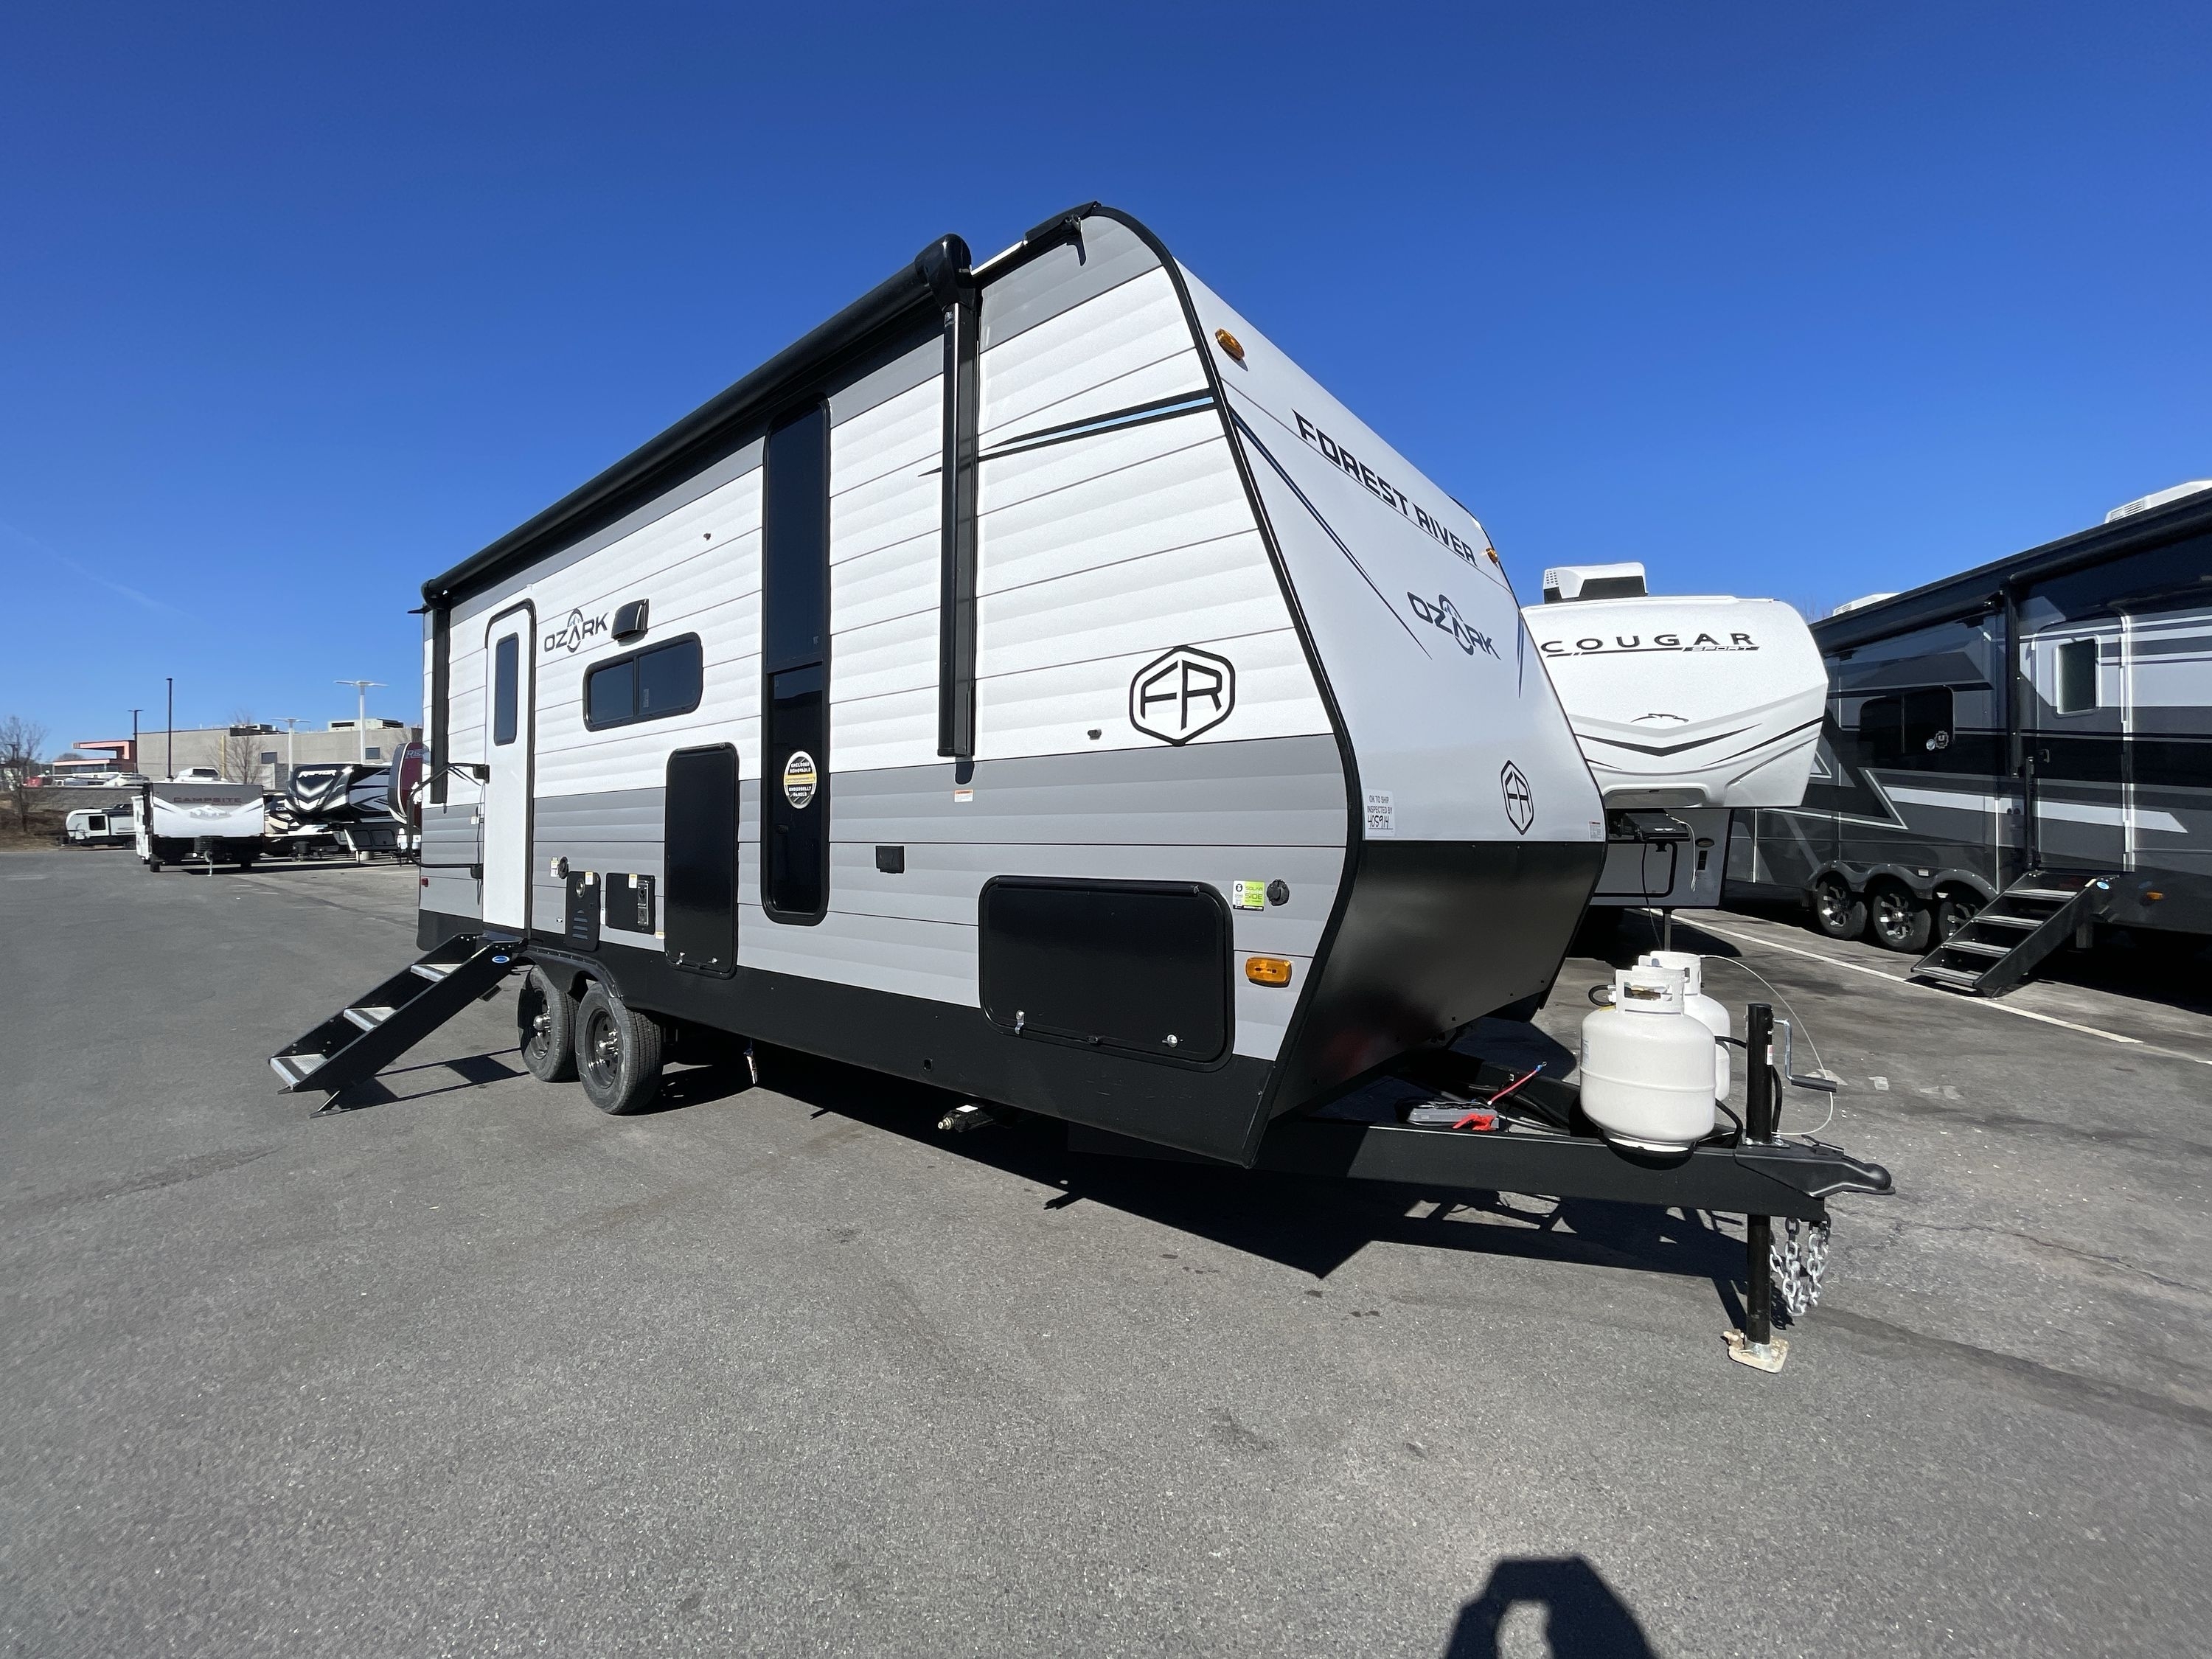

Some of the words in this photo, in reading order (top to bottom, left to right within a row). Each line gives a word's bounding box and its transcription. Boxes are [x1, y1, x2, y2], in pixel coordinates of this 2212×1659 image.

[1291, 408, 1408, 516] FOREST
[1412, 502, 1478, 568] RIVER
[544, 608, 609, 653] OZARK
[1407, 591, 1501, 661] OZARK
[1540, 633, 1756, 653] COUGAR
[1140, 659, 1222, 731] FR
[298, 770, 337, 779] RAPTOR
[1367, 805, 1387, 814] INSPECTED
[1387, 807, 1393, 815] BY
[1375, 796, 1381, 804] TO
